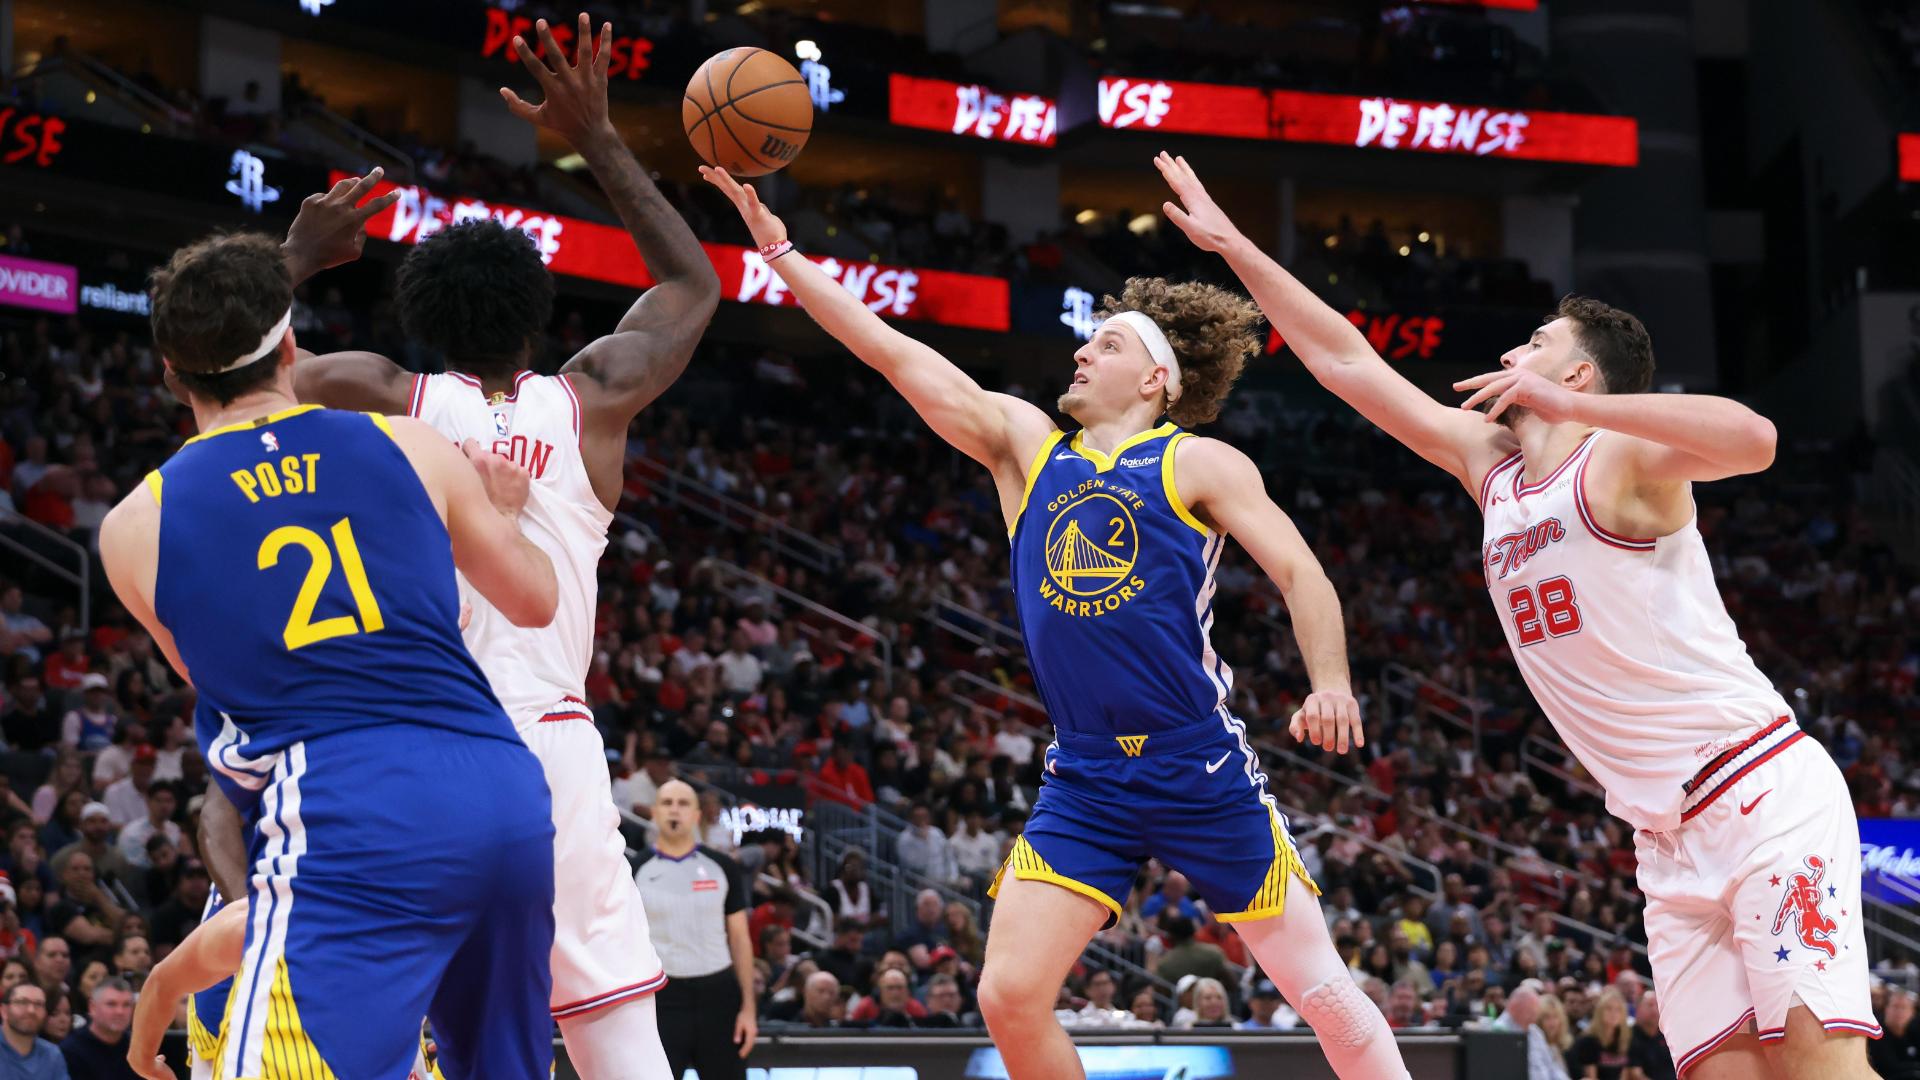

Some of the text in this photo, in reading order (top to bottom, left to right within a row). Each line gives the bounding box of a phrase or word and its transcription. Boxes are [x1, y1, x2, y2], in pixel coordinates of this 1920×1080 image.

[1354, 97, 1529, 156] DEFENSE
[80, 282, 151, 316] reliant
[230, 453, 321, 504] POST
[1119, 456, 1160, 468] Rakuten
[1047, 479, 1145, 513] GOLDEN STATE
[1107, 517, 1126, 547] 2
[257, 516, 385, 651] 21
[1038, 575, 1147, 618] WARRIORS
[1507, 574, 1584, 648] 28
